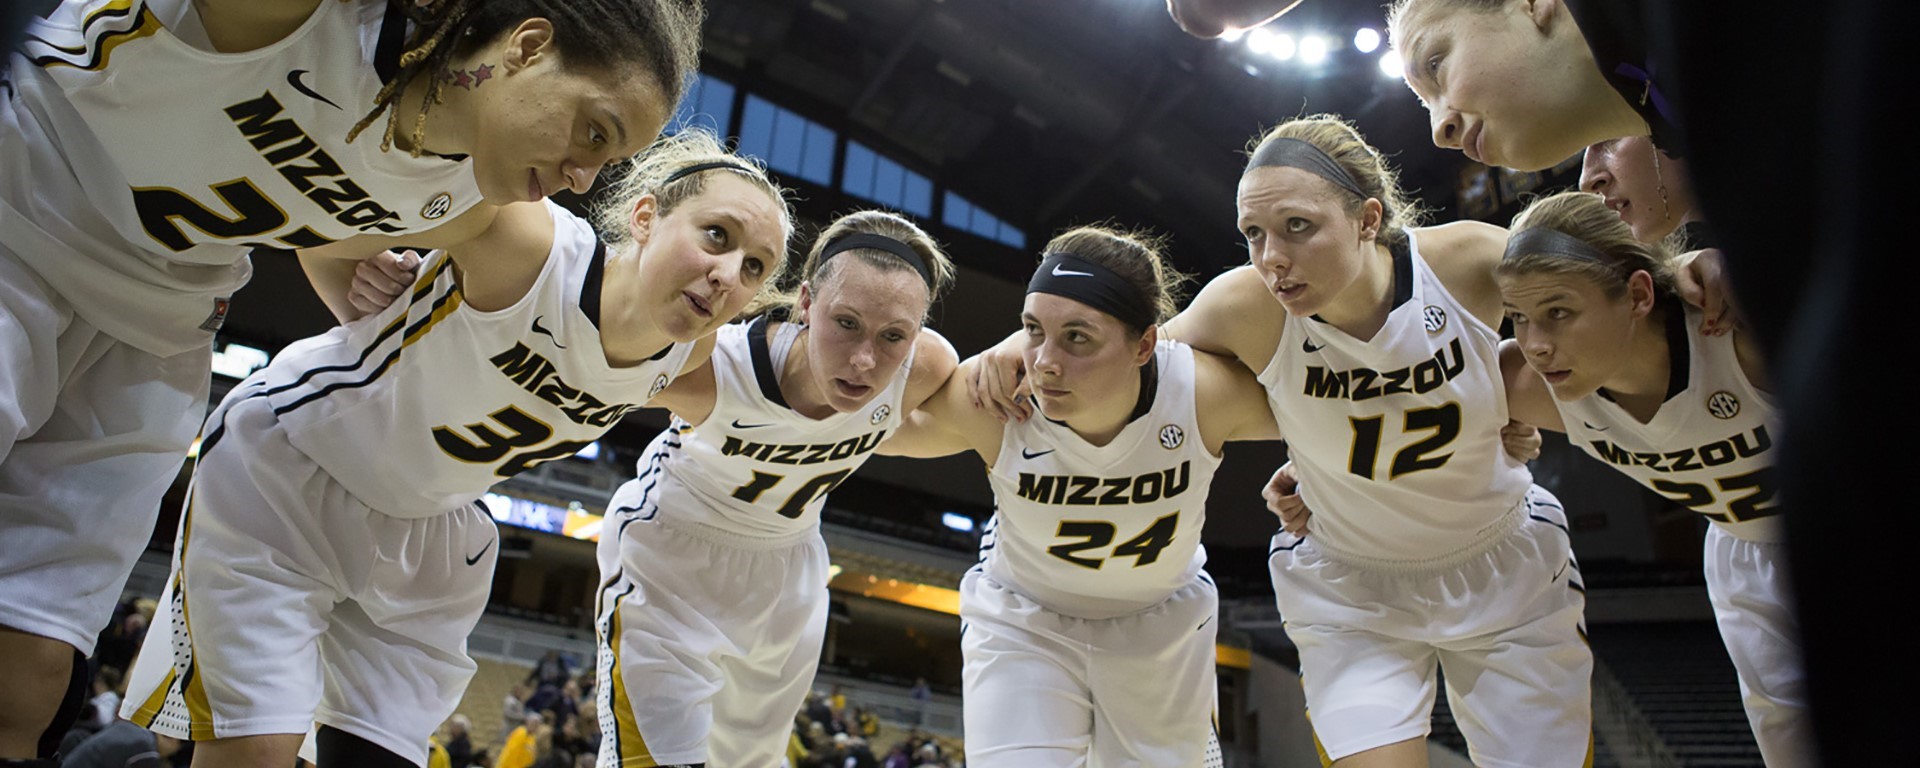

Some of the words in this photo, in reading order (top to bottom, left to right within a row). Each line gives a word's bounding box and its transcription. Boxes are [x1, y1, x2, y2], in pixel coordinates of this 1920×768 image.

[131, 176, 340, 252] 2
[489, 340, 638, 427] MIZZO
[1303, 337, 1465, 401] MIZZOU
[1708, 390, 1740, 420] SEC
[721, 429, 888, 465] MIZZOU
[1159, 424, 1184, 450] SEC
[1348, 401, 1462, 481] 12
[1017, 460, 1191, 505] MIZZOU
[1649, 466, 1784, 523] 22
[1046, 509, 1181, 570] 24
